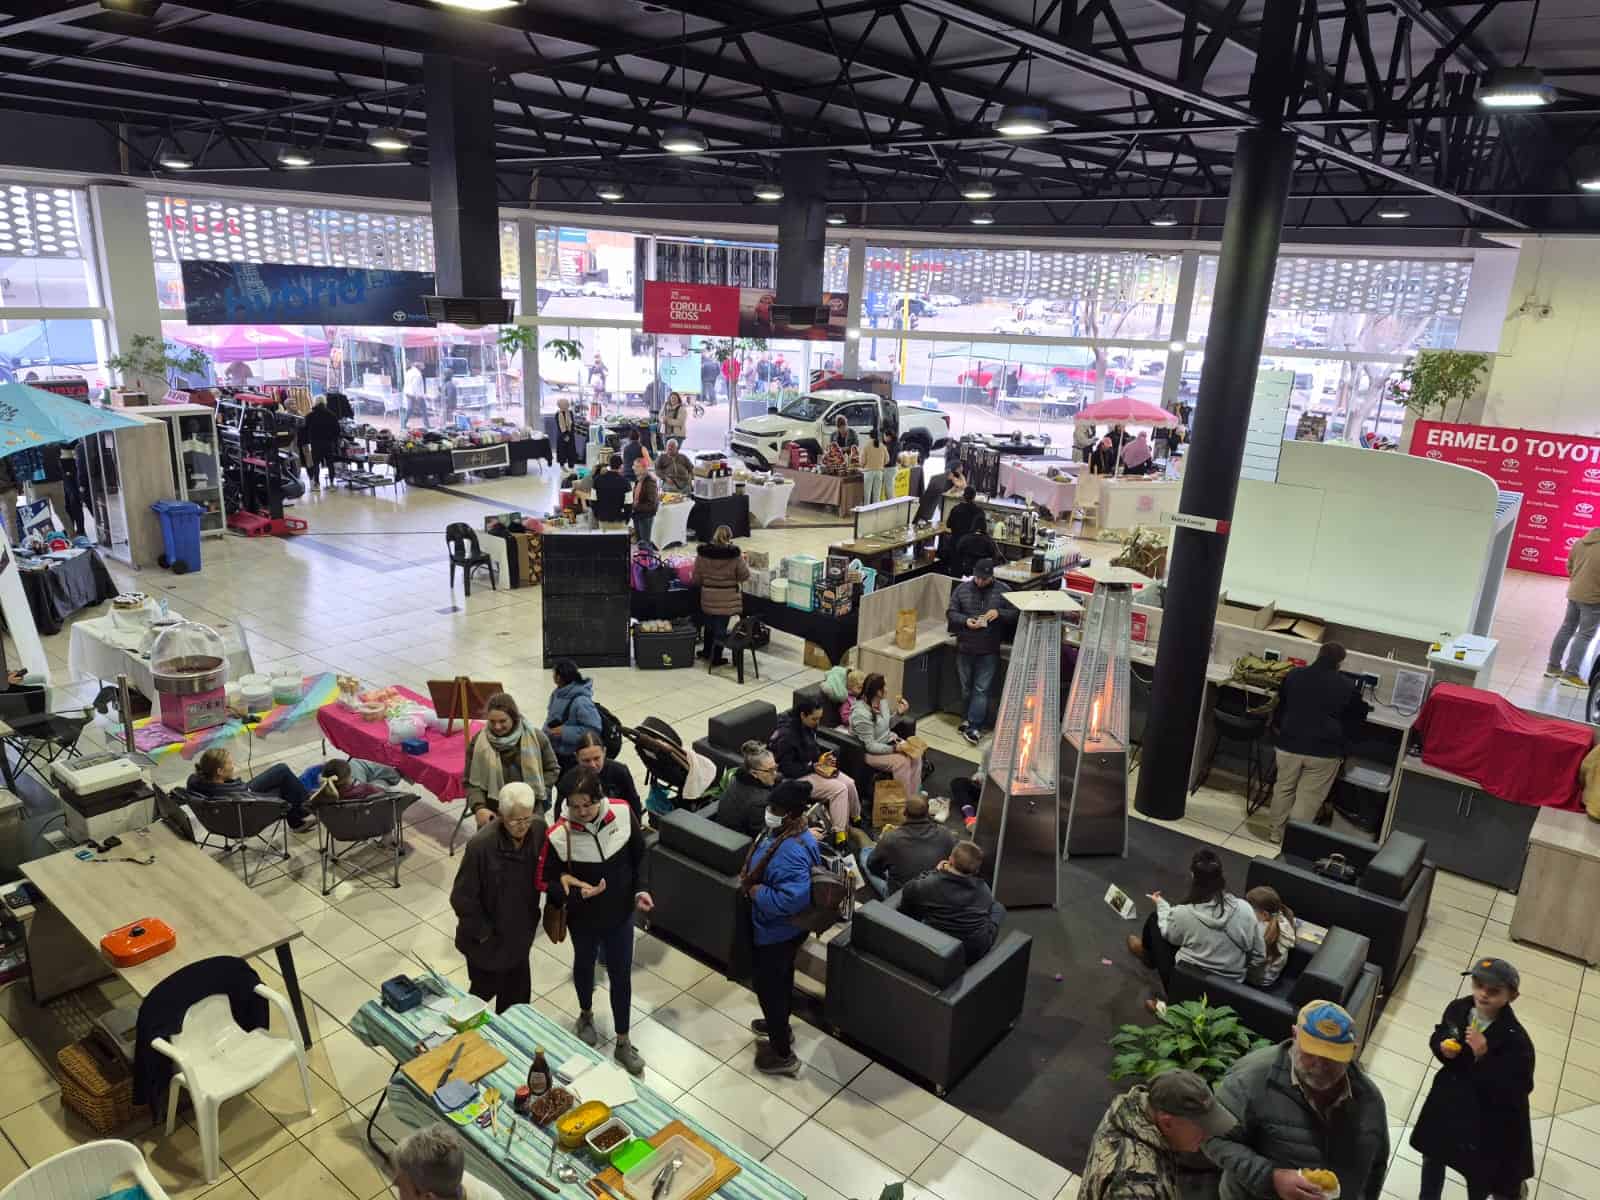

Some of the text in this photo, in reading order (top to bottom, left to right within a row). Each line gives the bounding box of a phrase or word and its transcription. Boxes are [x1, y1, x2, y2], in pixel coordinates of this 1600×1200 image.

[670, 300, 712, 313] COROLLA
[670, 311, 699, 321] CROSS
[1426, 429, 1600, 464] ERMELO TOYOT
